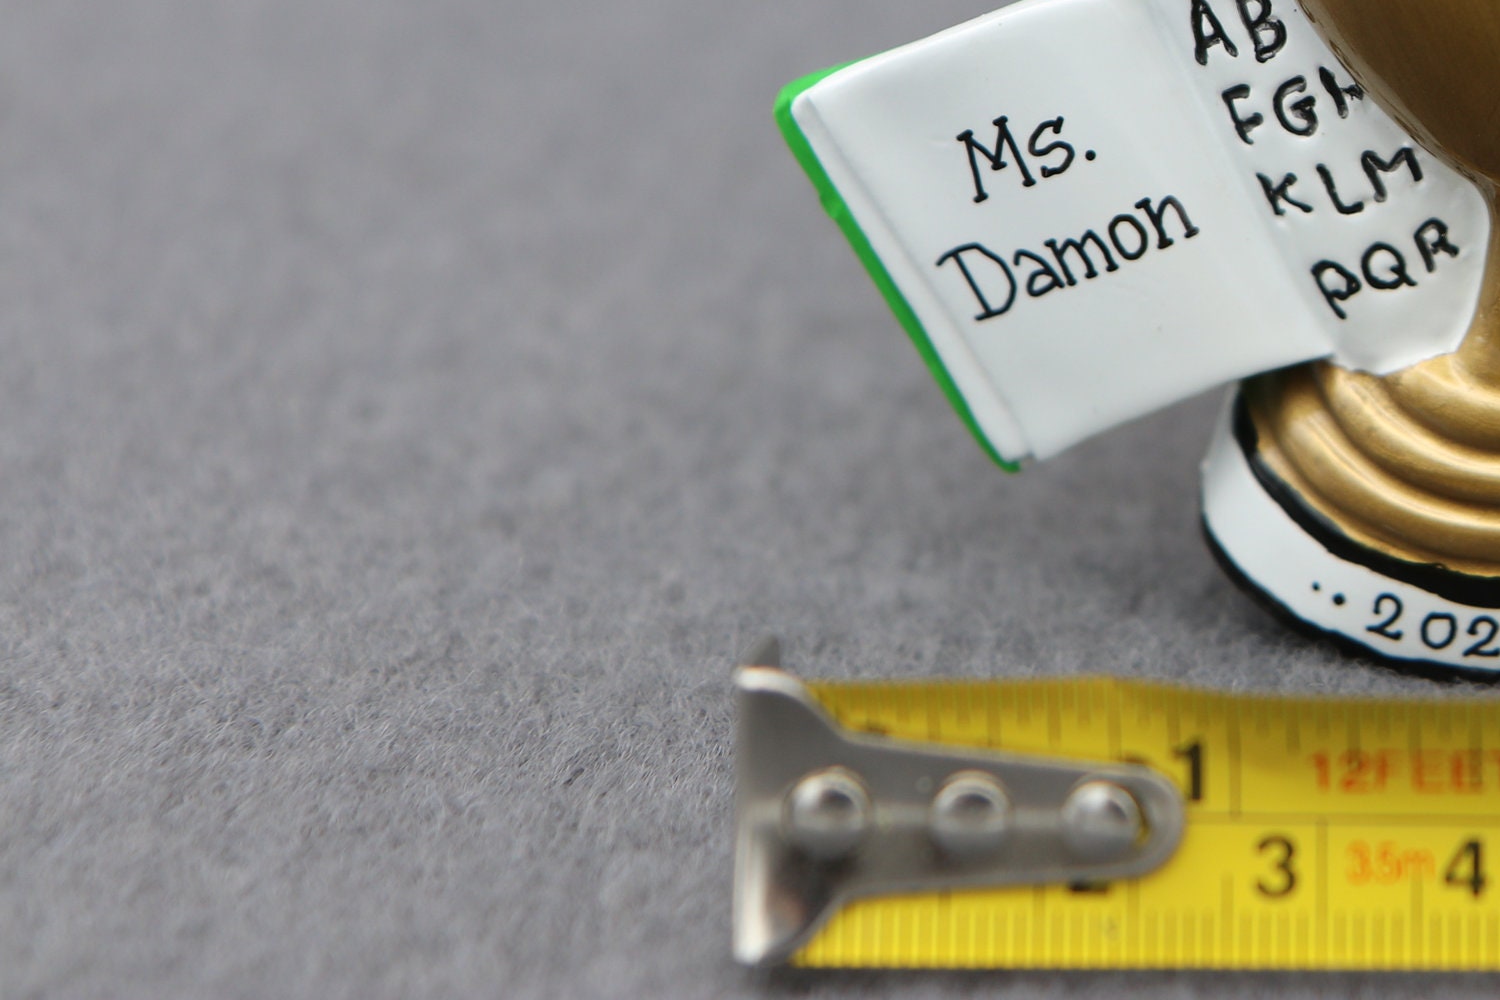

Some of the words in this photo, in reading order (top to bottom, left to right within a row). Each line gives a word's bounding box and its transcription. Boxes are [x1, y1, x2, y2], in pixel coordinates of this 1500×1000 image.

[956, 115, 1097, 203] Ms.
[936, 194, 1200, 322] Damon
[1174, 736, 1206, 802] 1
[1254, 834, 1300, 900] 3
[1444, 837, 1488, 898] 4
